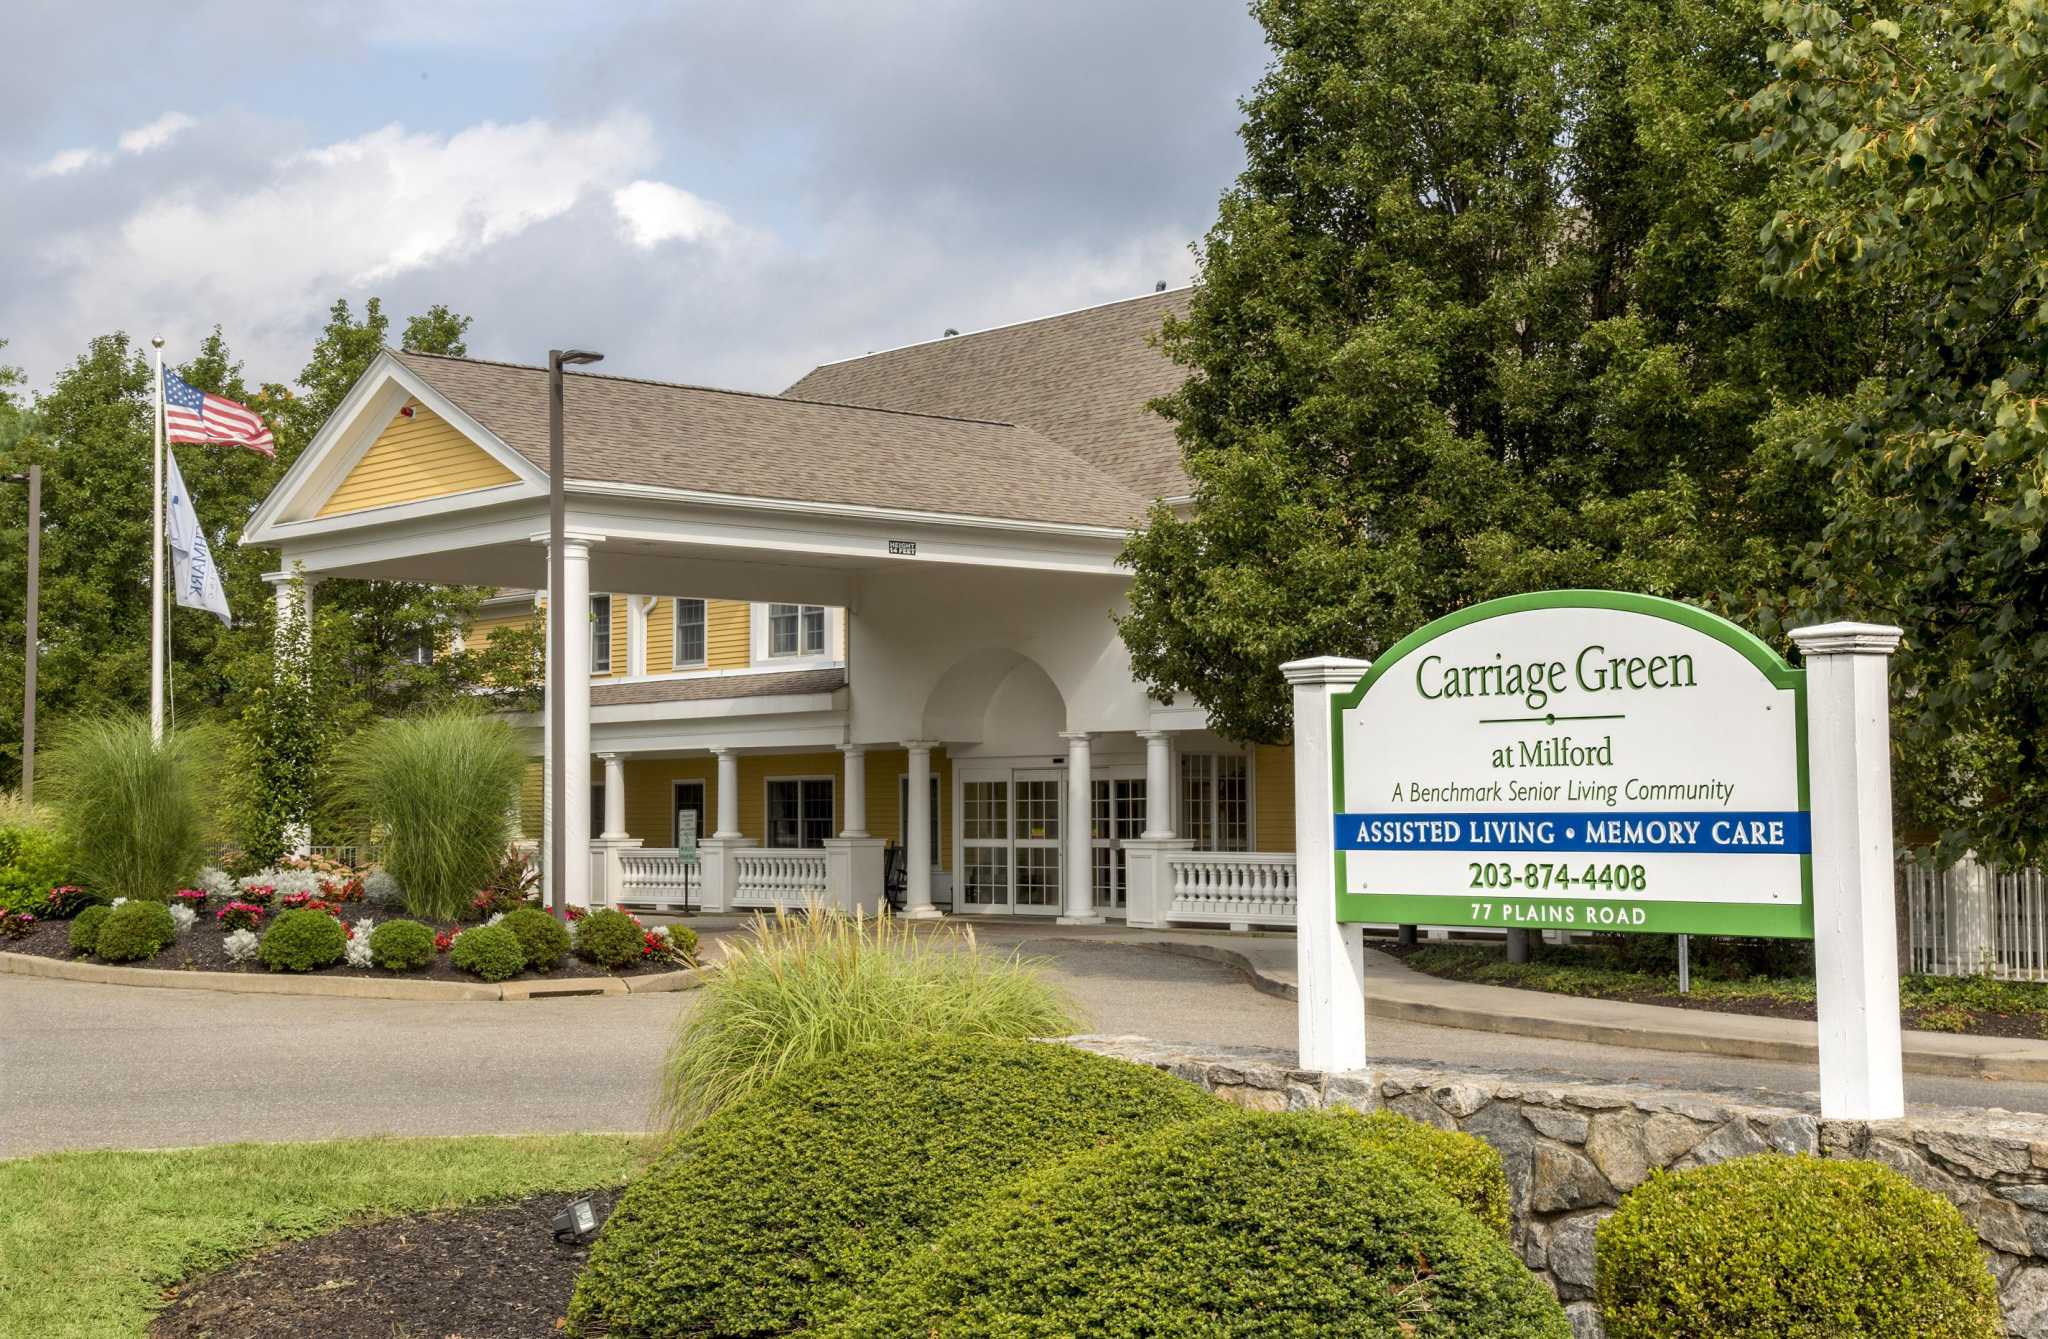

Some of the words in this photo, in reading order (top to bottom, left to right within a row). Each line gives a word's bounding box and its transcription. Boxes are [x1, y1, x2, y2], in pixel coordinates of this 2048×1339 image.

[1416, 653, 1567, 710] Carriage
[1575, 645, 1698, 692] Green
[1491, 745, 1515, 768] at
[1518, 736, 1614, 768] Milford
[1391, 783, 1404, 802] A
[1410, 781, 1502, 803] Benchmark
[1508, 780, 1562, 802] Senior
[1567, 780, 1618, 807] Living
[1624, 778, 1735, 807] Community
[1356, 821, 1461, 843] ASSISTED
[1470, 821, 1555, 843] LIVING
[1585, 821, 1701, 844] MEMORY
[1711, 821, 1785, 845] CARE
[1468, 863, 1647, 891] 203-874-4408
[1471, 904, 1492, 921] 77
[1503, 904, 1575, 923] PLAINS
[1586, 906, 1646, 925] ROAD
